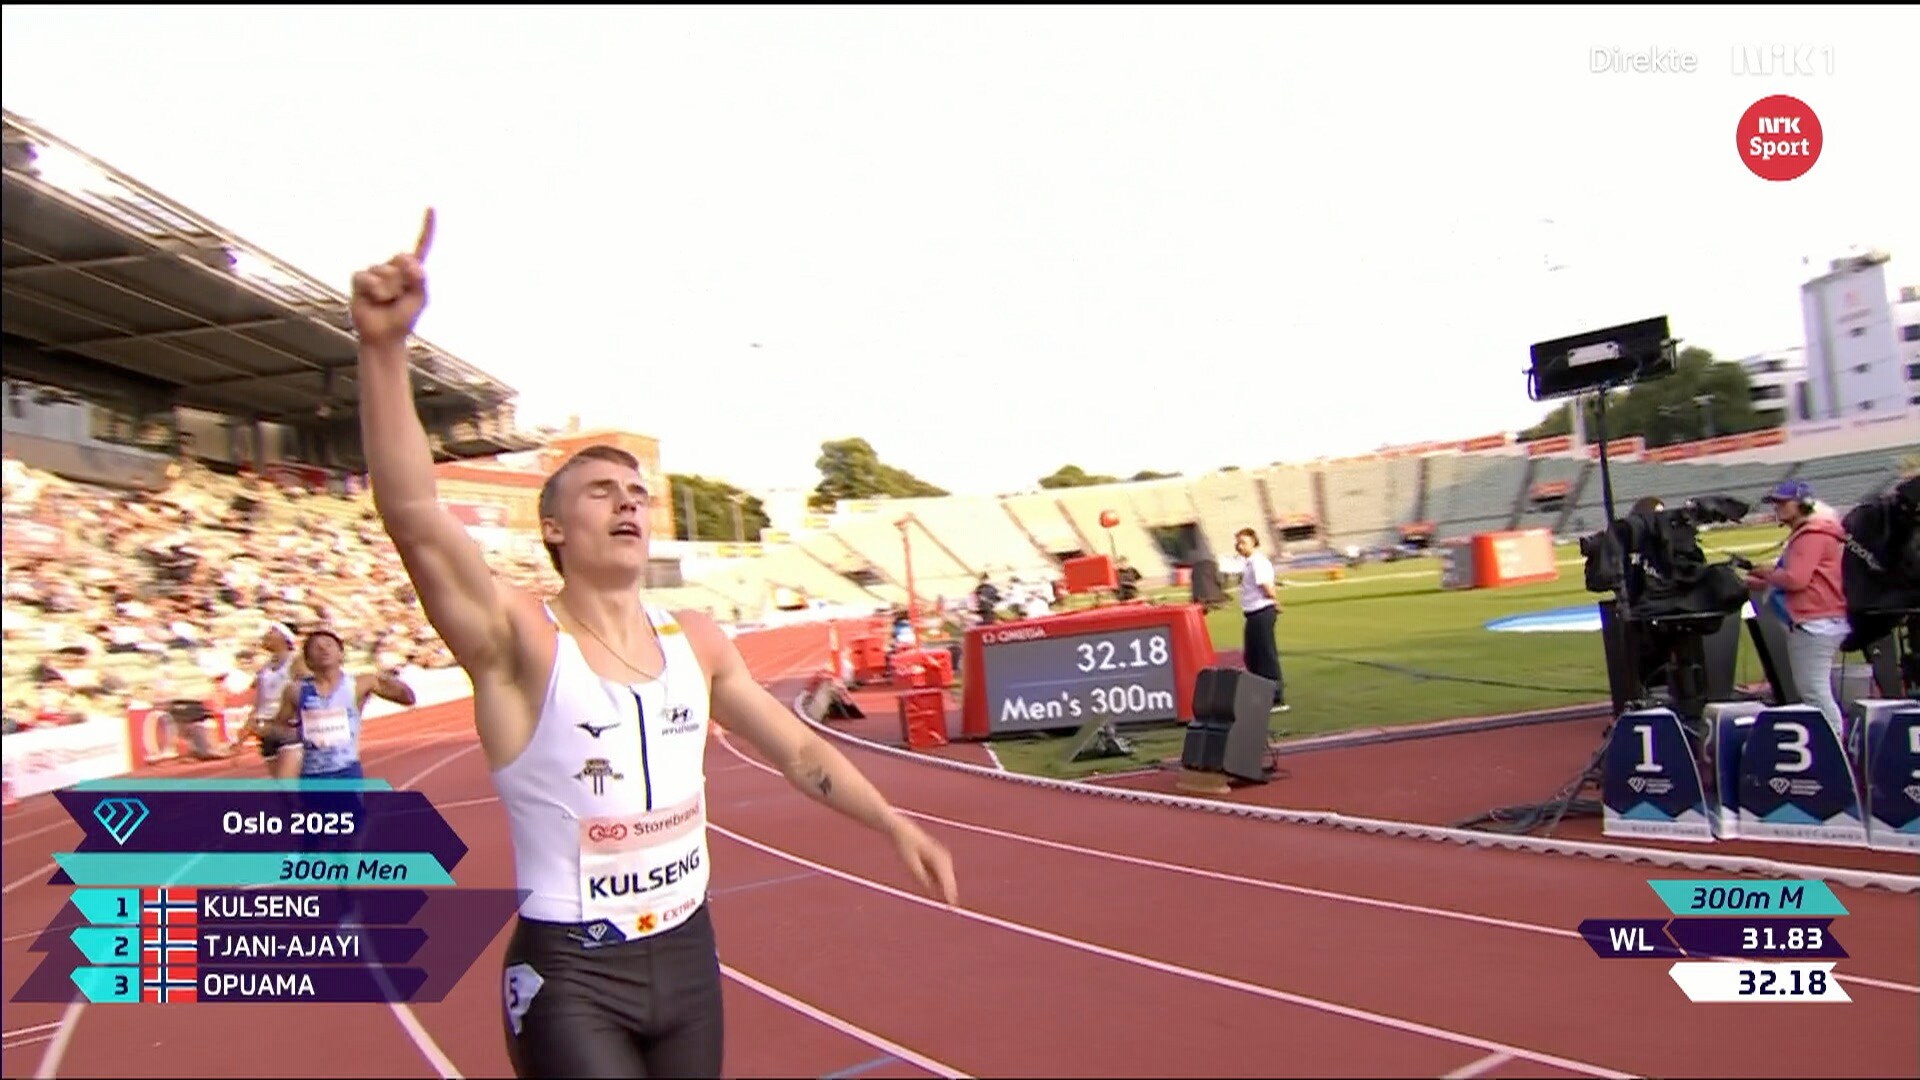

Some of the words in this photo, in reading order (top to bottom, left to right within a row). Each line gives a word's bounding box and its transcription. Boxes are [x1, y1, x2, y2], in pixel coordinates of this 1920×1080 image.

[1076, 634, 1169, 672] 32.18
[1000, 690, 1082, 722] Men's
[1090, 684, 1174, 714] 300m
[1632, 724, 1664, 773] 1
[1773, 721, 1813, 773] 3
[632, 801, 700, 837] Storebrand
[589, 845, 700, 901] KULSENG
[662, 897, 697, 922] EXTRA
